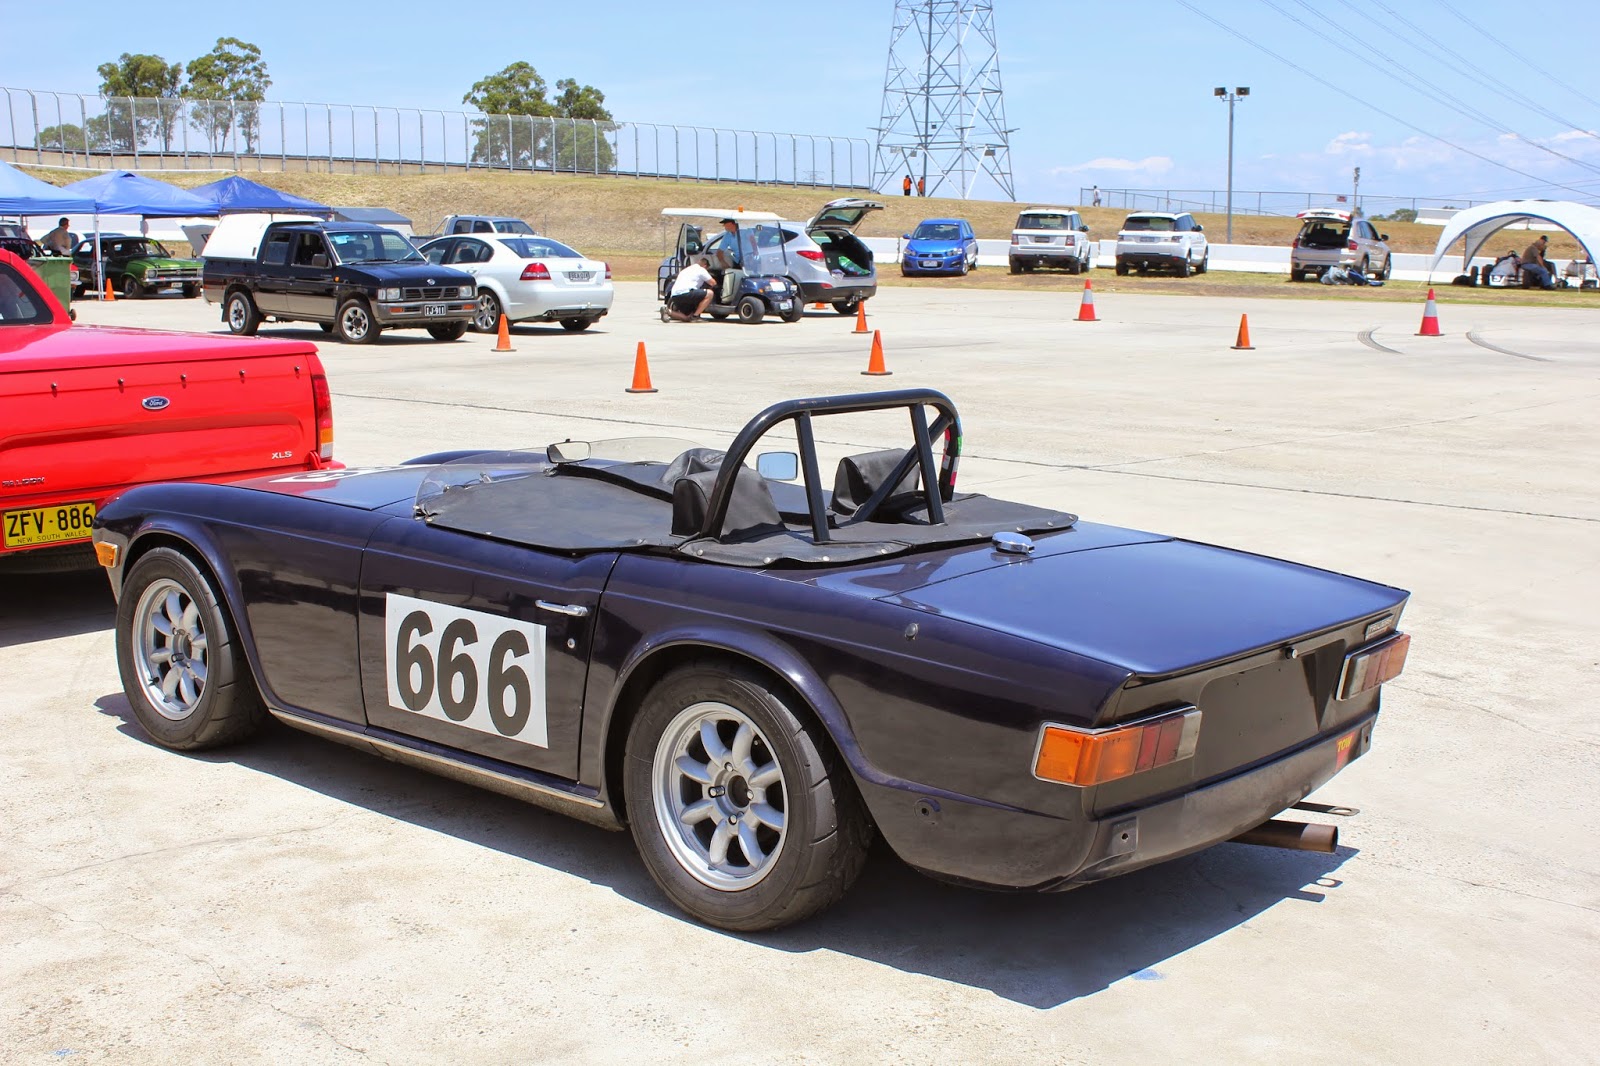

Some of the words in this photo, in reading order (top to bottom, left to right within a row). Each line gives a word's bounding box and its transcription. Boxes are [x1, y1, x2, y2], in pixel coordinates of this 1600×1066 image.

[149, 398, 164, 407] Ford
[271, 450, 293, 460] XLS
[37, 533, 60, 541] SOUTH
[65, 530, 88, 538] WALES
[396, 610, 532, 737] 666
